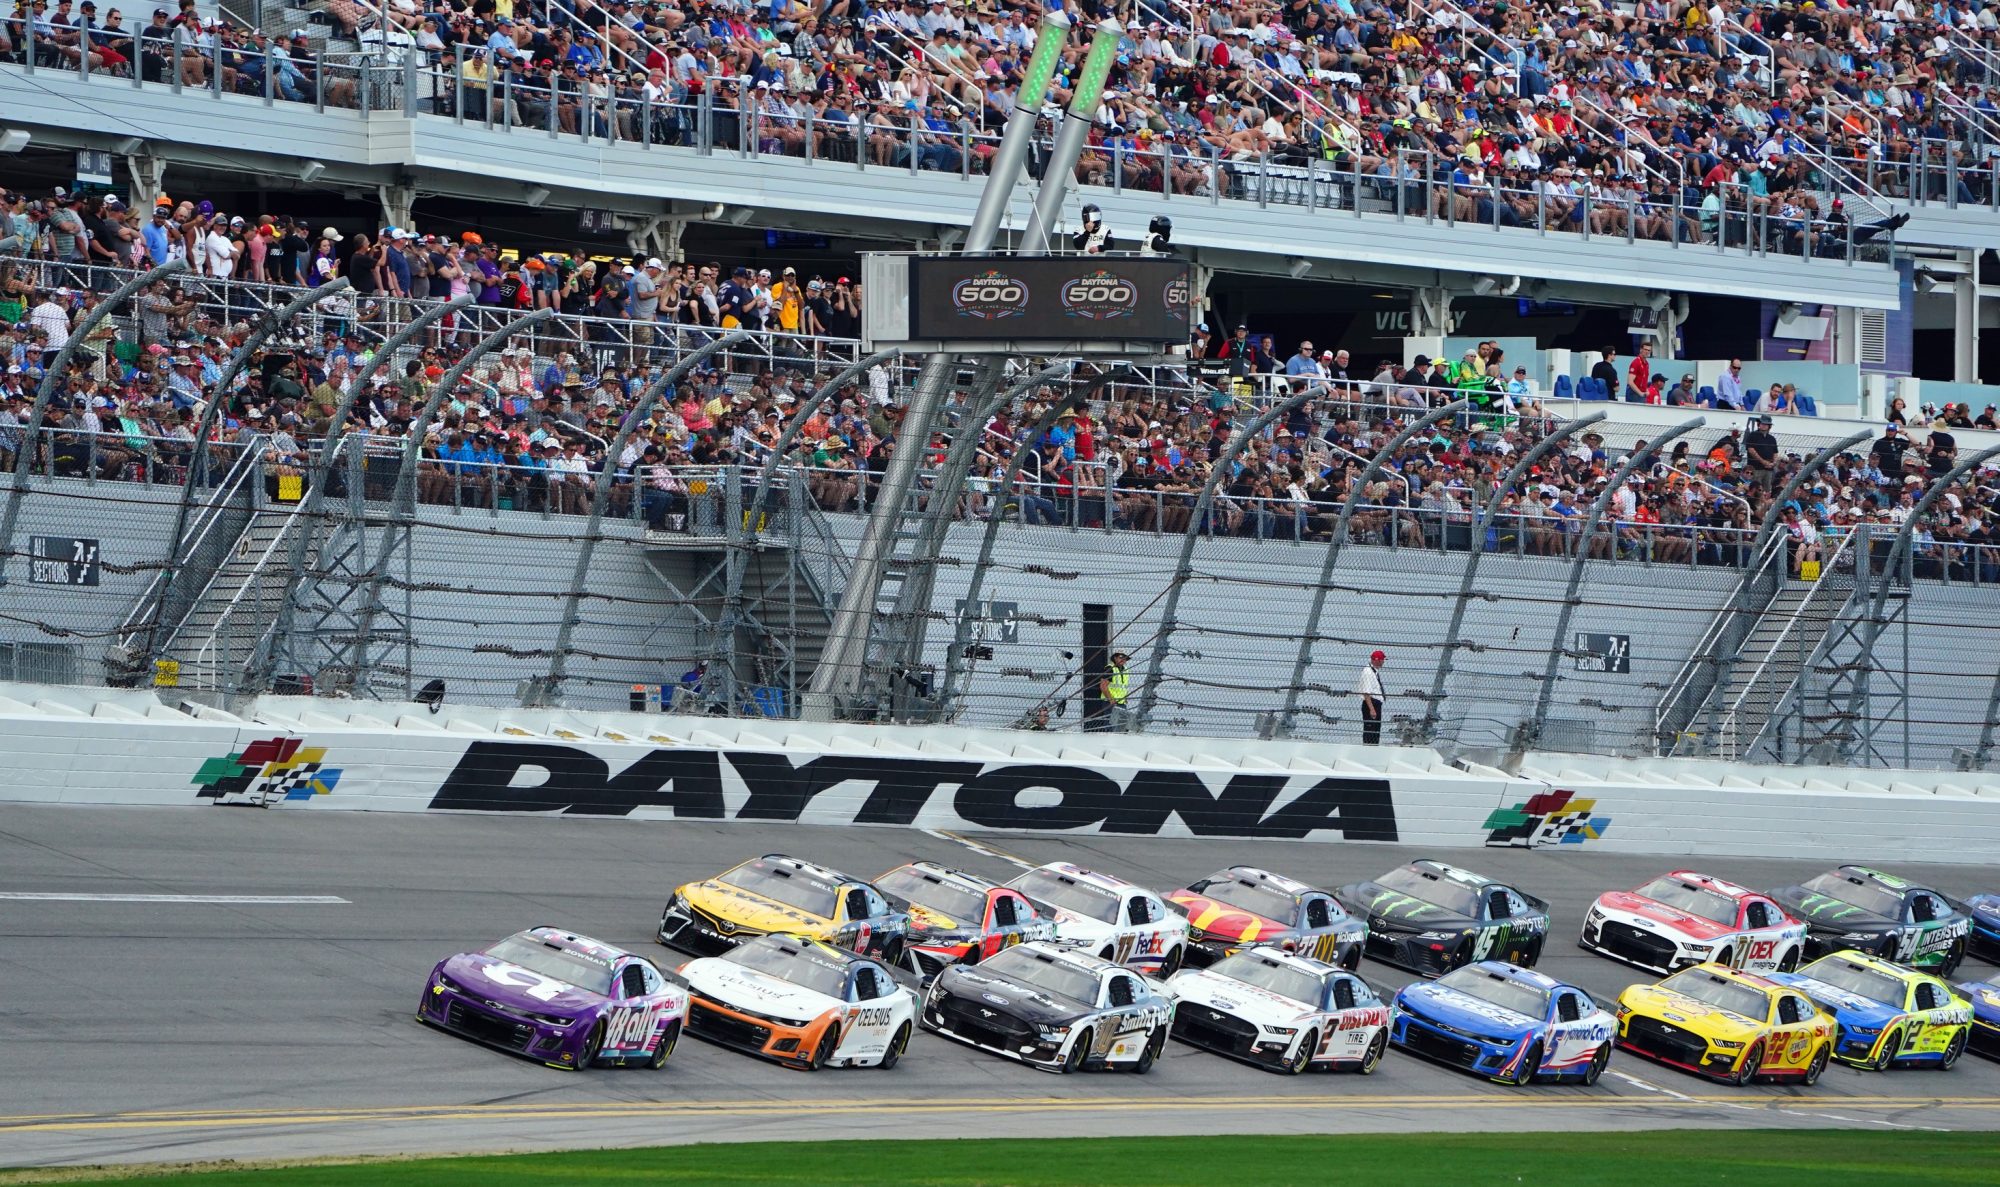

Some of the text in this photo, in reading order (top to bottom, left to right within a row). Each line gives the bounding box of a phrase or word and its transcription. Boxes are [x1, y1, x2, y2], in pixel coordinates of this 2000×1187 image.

[80, 151, 110, 172] 146 145
[583, 210, 594, 227] 145
[960, 287, 1021, 302] 500
[1068, 287, 1130, 302] 500
[1168, 289, 1189, 304] 50
[1375, 311, 1467, 331] VICY
[34, 538, 47, 558] ALL
[33, 560, 69, 584] SECTIONS
[1578, 634, 1589, 652] ALL
[427, 741, 1399, 842] DAYTONA
[810, 880, 833, 892] BELL
[940, 880, 970, 893] TRUEX
[1082, 883, 1118, 899] HAMLIN
[1703, 888, 1734, 901] BURTON
[1135, 931, 1165, 955] FedEx
[1473, 926, 1500, 961] 45
[1749, 941, 1779, 959] DEX
[1896, 927, 1924, 960] 54
[1919, 939, 1954, 956] BATTERIES
[565, 948, 607, 967] BOWMAN
[1733, 936, 1755, 969] 21
[811, 957, 846, 973] LAJOIE
[1752, 960, 1776, 970] imaging
[1508, 980, 1542, 994] LARSON
[1733, 982, 1764, 996] LOGANO
[664, 998, 675, 1009] do
[625, 1001, 660, 1052] ally
[858, 1008, 892, 1027] CELSIUS
[602, 1008, 632, 1049] 48
[1316, 1018, 1340, 1055] 2
[1899, 1020, 1925, 1051] 12
[1347, 1033, 1364, 1043] TIRE
[1762, 1032, 1791, 1065] 22
